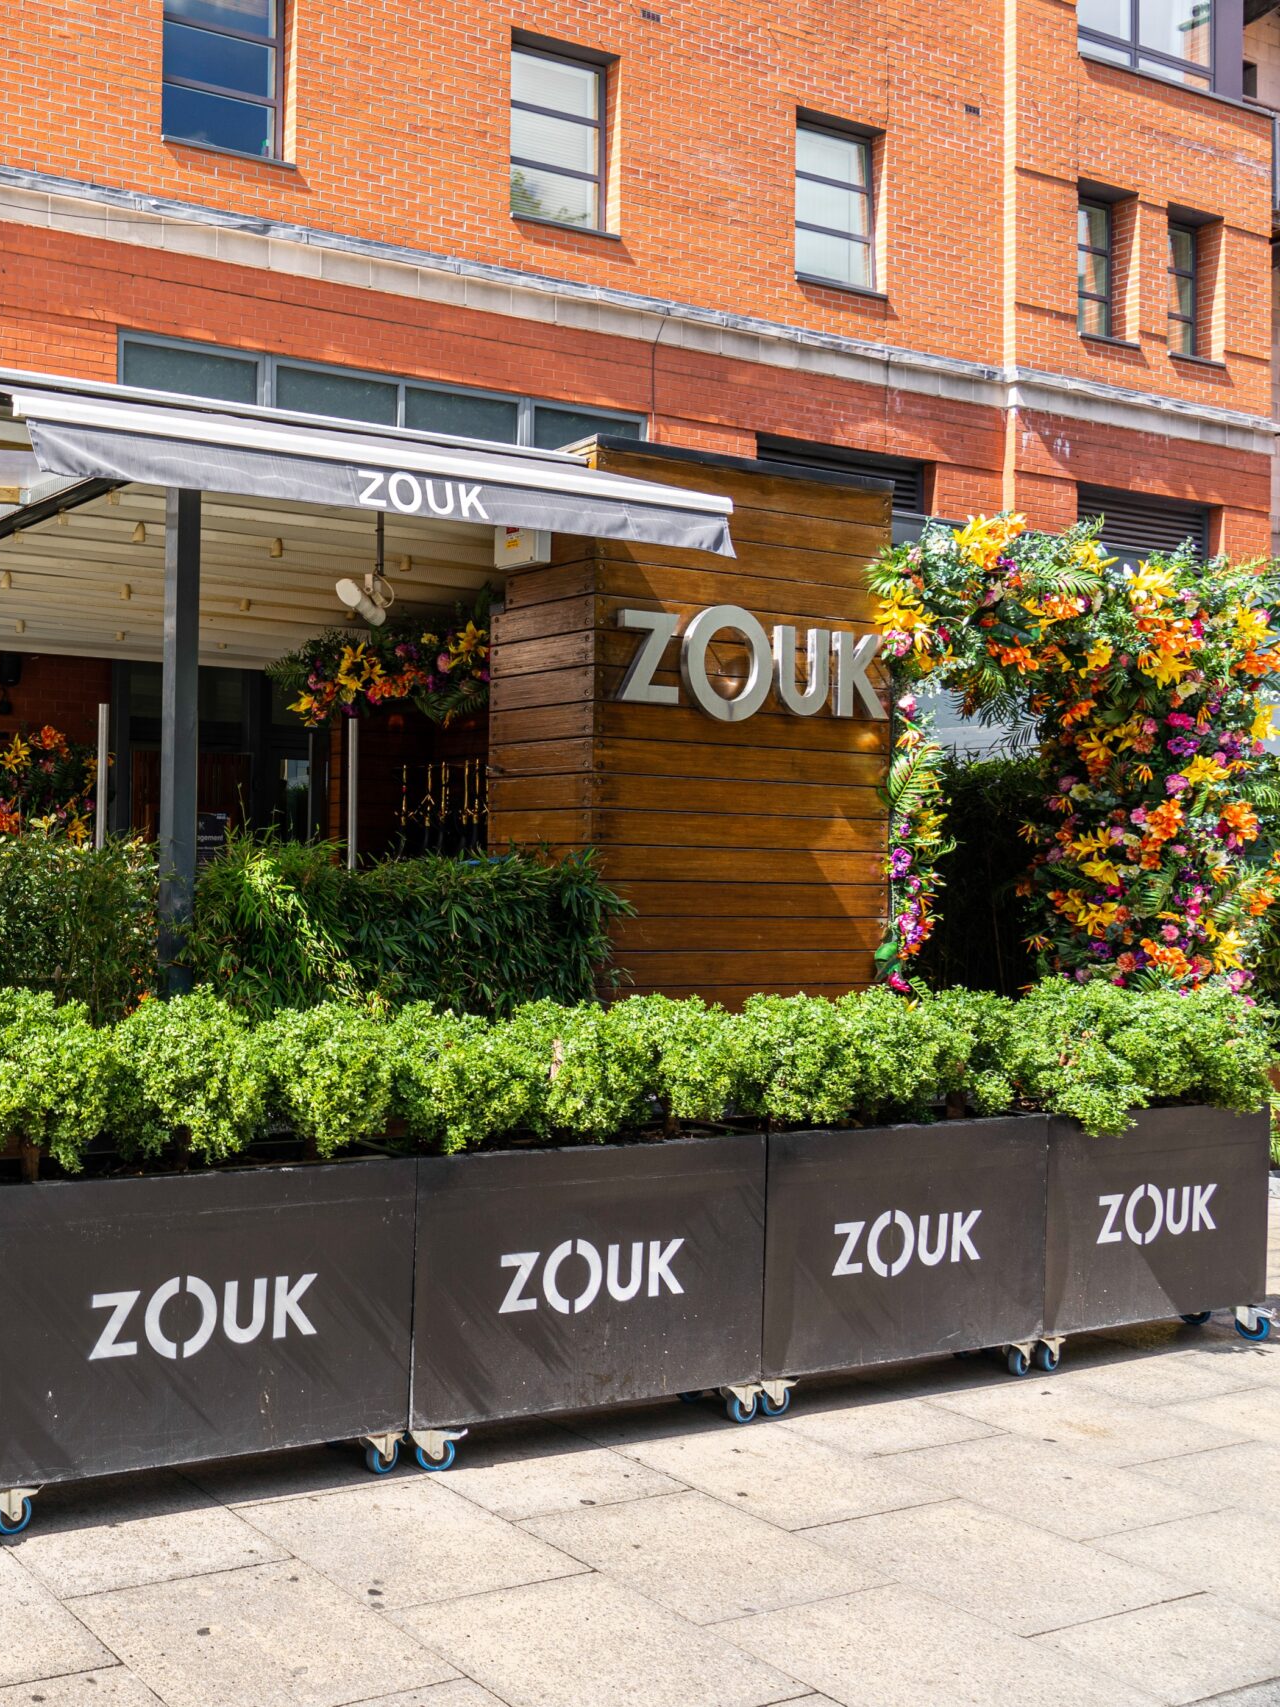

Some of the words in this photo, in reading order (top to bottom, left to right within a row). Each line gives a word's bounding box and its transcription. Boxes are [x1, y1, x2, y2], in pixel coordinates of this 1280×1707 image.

[357, 470, 489, 520] ZOUK
[617, 604, 890, 722] ZOUK
[831, 1209, 983, 1278] ZOUK
[1095, 1183, 1218, 1246] ZOUK
[498, 1238, 685, 1315] ZOUK
[88, 1272, 318, 1361] ZOUK
